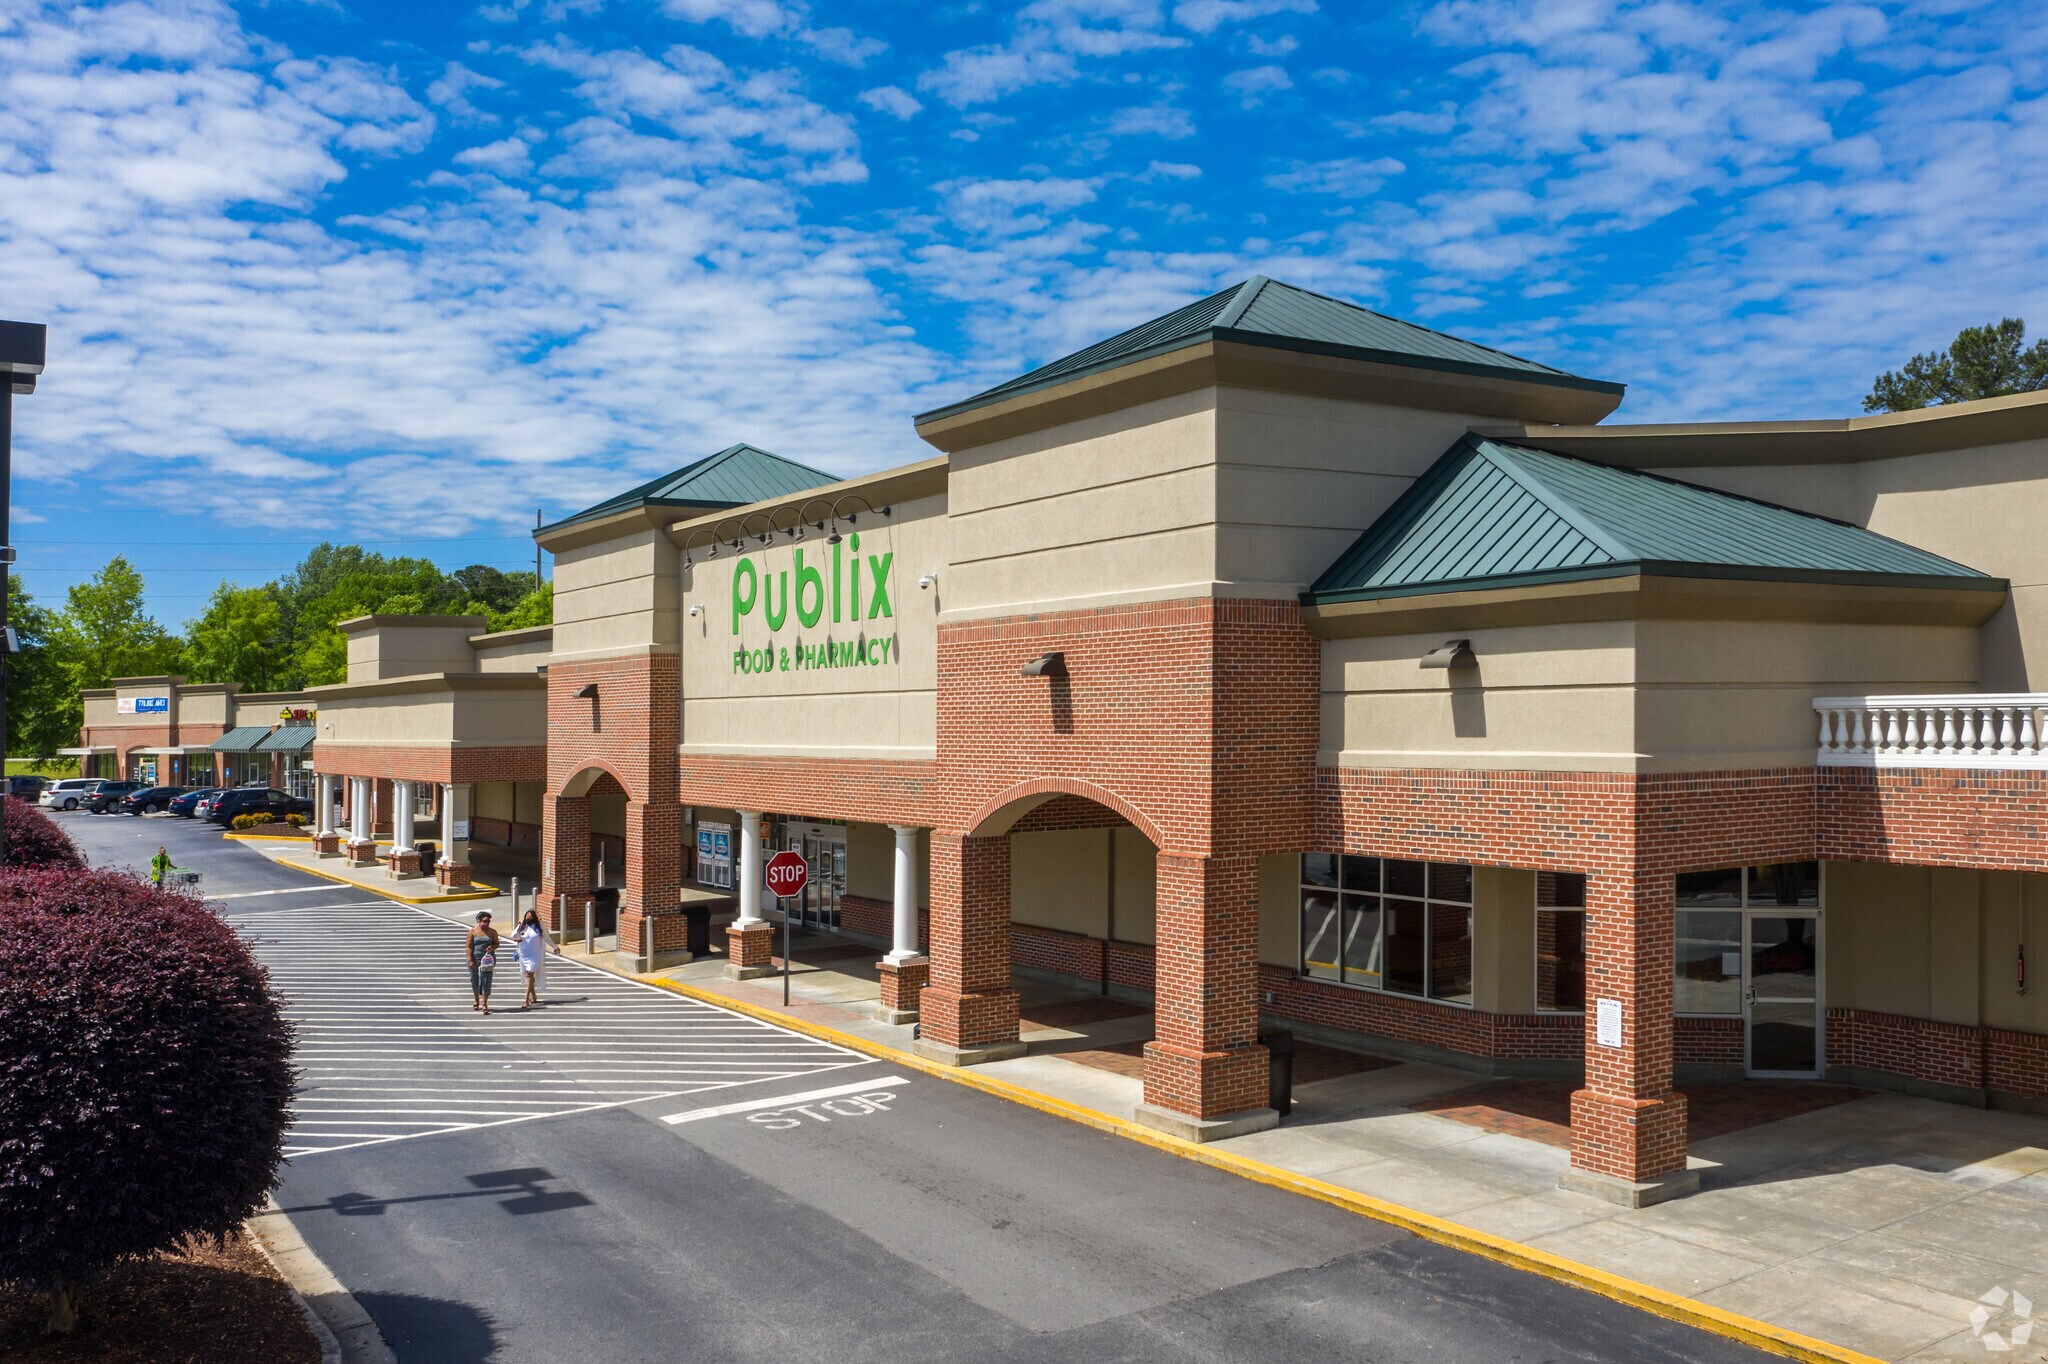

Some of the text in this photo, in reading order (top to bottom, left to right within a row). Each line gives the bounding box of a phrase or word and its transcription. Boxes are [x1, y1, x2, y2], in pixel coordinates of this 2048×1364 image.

[732, 532, 893, 635] Publix
[733, 637, 892, 674] FOOD & PHARMACY
[769, 864, 805, 883] STOP
[746, 1092, 897, 1130] STOP
